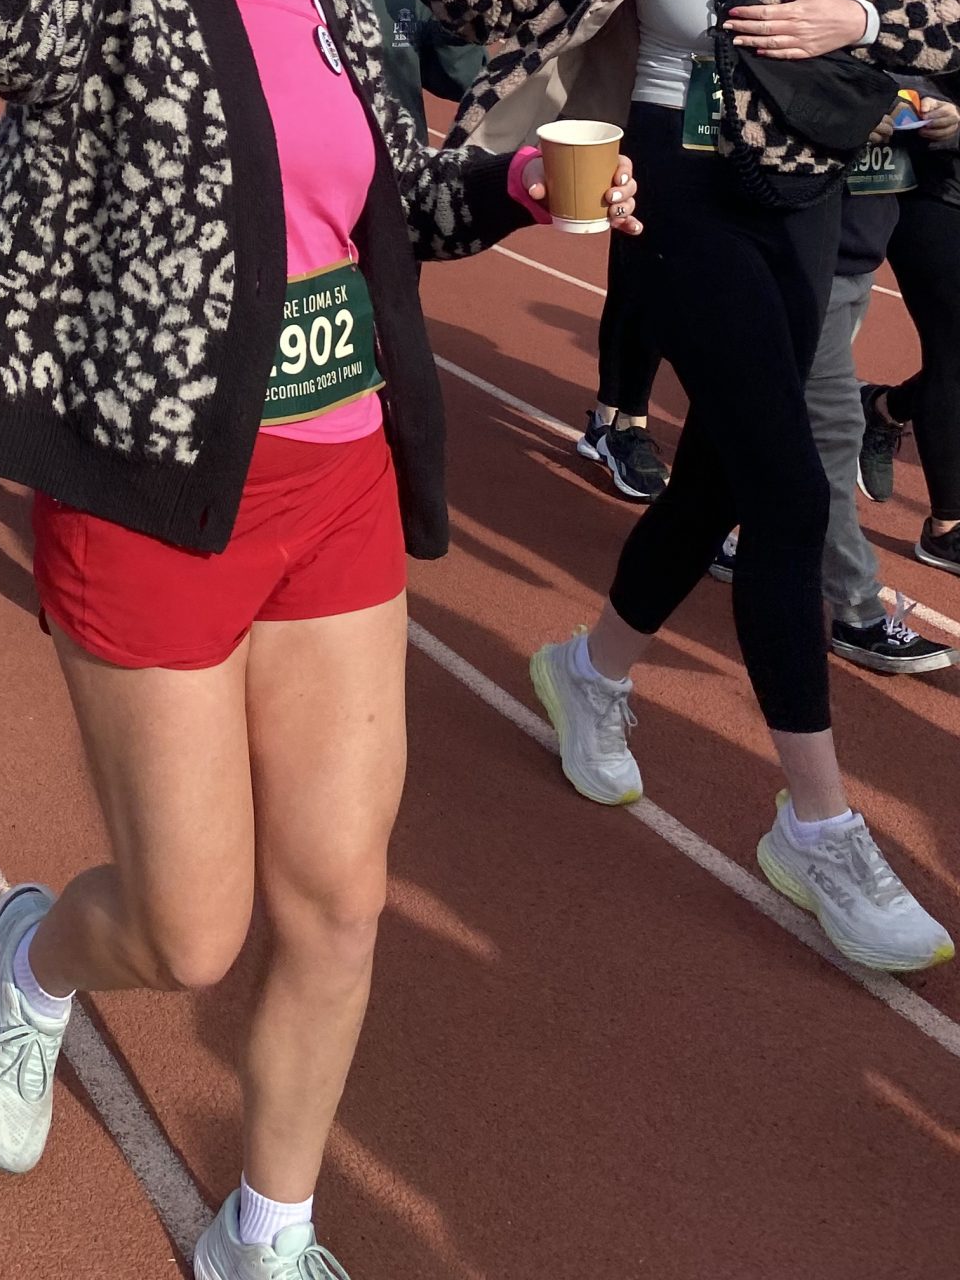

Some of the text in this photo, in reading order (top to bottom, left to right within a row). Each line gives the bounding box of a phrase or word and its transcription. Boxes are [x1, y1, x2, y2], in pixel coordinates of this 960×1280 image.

[854, 146, 896, 172] 902
[303, 290, 333, 314] LOMA
[270, 309, 354, 377] 902
[317, 373, 338, 391] 2023
[343, 361, 363, 380] PLNU
